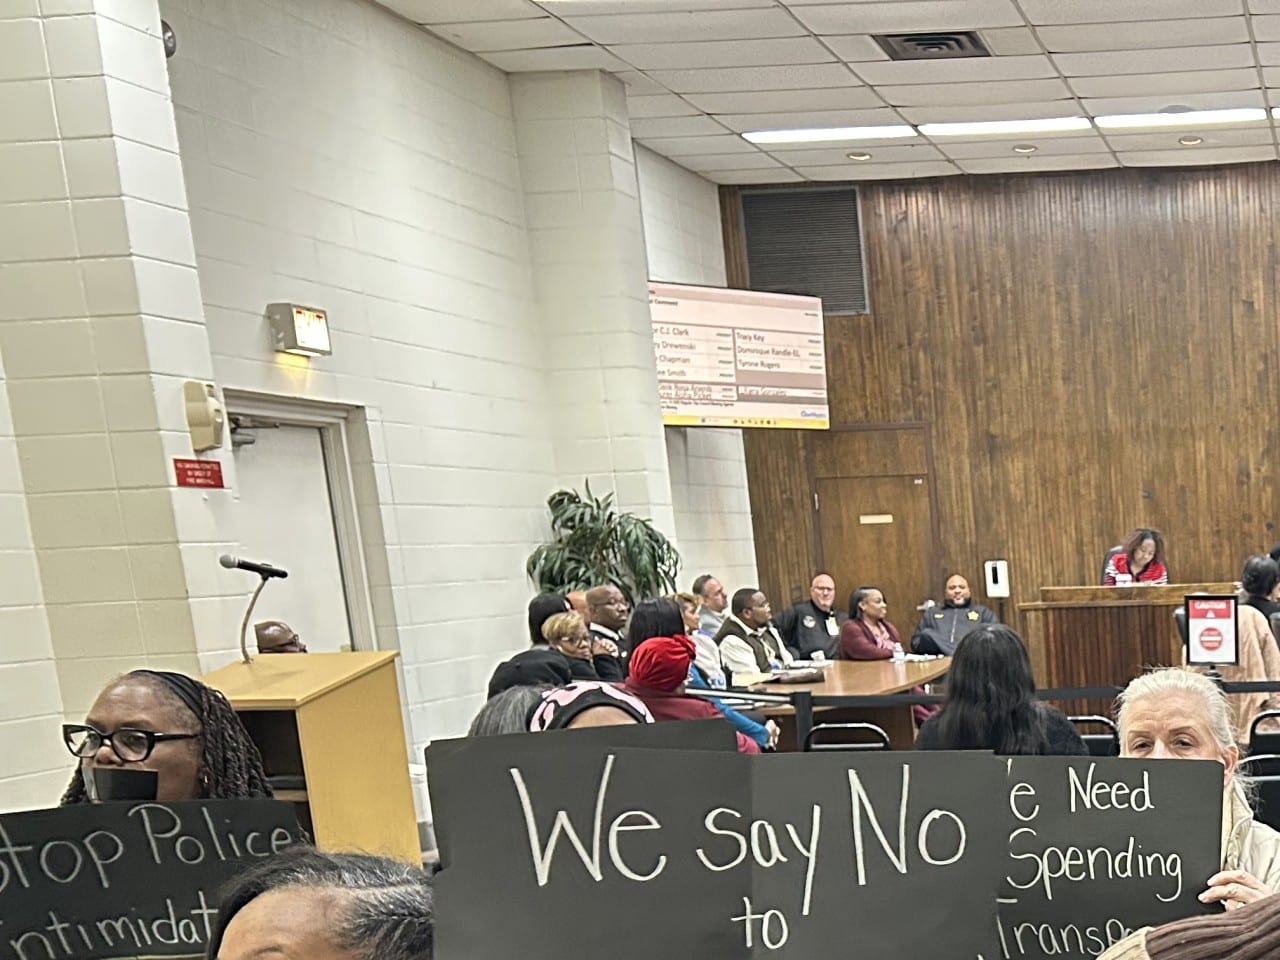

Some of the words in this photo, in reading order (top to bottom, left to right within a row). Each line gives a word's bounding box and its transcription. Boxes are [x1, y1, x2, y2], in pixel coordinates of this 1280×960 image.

[509, 753, 666, 888] We
[848, 763, 967, 888] No
[1007, 758, 1040, 821] e
[1068, 762, 1155, 813] Need
[127, 802, 293, 865] Police
[1006, 827, 1183, 903] Spending
[731, 896, 790, 951] to
